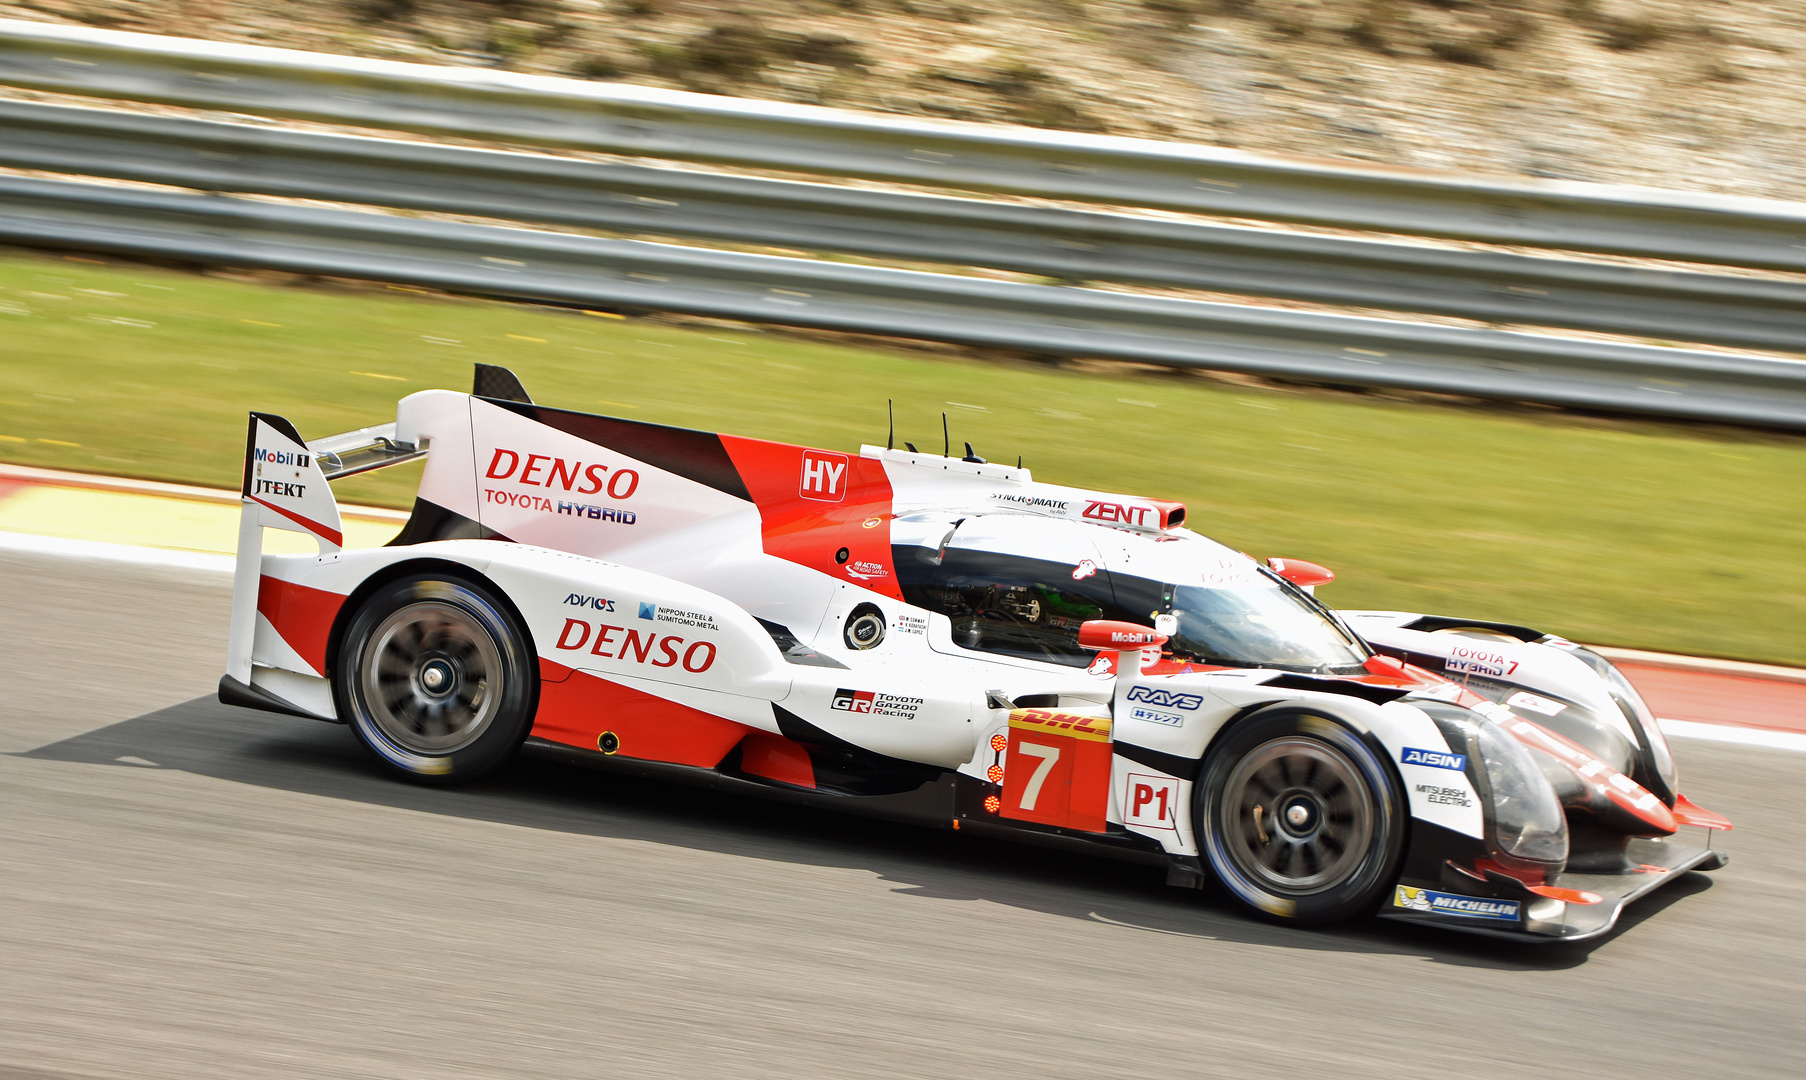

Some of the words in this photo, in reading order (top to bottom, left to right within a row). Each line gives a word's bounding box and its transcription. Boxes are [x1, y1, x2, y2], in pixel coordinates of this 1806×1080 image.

[255, 448, 293, 465] Mobil
[296, 454, 310, 468] 1
[485, 448, 639, 500] DENSO
[802, 458, 845, 494] HY
[254, 479, 306, 498] JTEKT
[484, 489, 553, 513] TOYOTA
[557, 500, 636, 525] HYBRID
[1082, 499, 1152, 526] ZENT
[657, 614, 695, 627] SUMITOMO
[696, 621, 719, 631] METAL
[658, 607, 686, 618] NIPPON
[686, 611, 708, 621] STEEL
[555, 618, 717, 673] DENSO
[1111, 632, 1142, 643] Mobil
[1452, 646, 1504, 664] TOYOTA
[1506, 660, 1519, 675] 7
[832, 696, 872, 713] GR
[879, 693, 923, 704] TOYOTA
[875, 701, 918, 711] GAZOO
[1127, 686, 1203, 710] RAYS
[873, 708, 915, 720] Racing
[1021, 709, 1097, 733] DHL
[1405, 751, 1462, 768] AISIN
[1018, 741, 1060, 811] 7
[1416, 784, 1467, 798] MITSUBISHI
[1132, 783, 1168, 821] P1
[1428, 794, 1471, 808] ELECTRIC
[1433, 897, 1517, 915] MICHELIN
